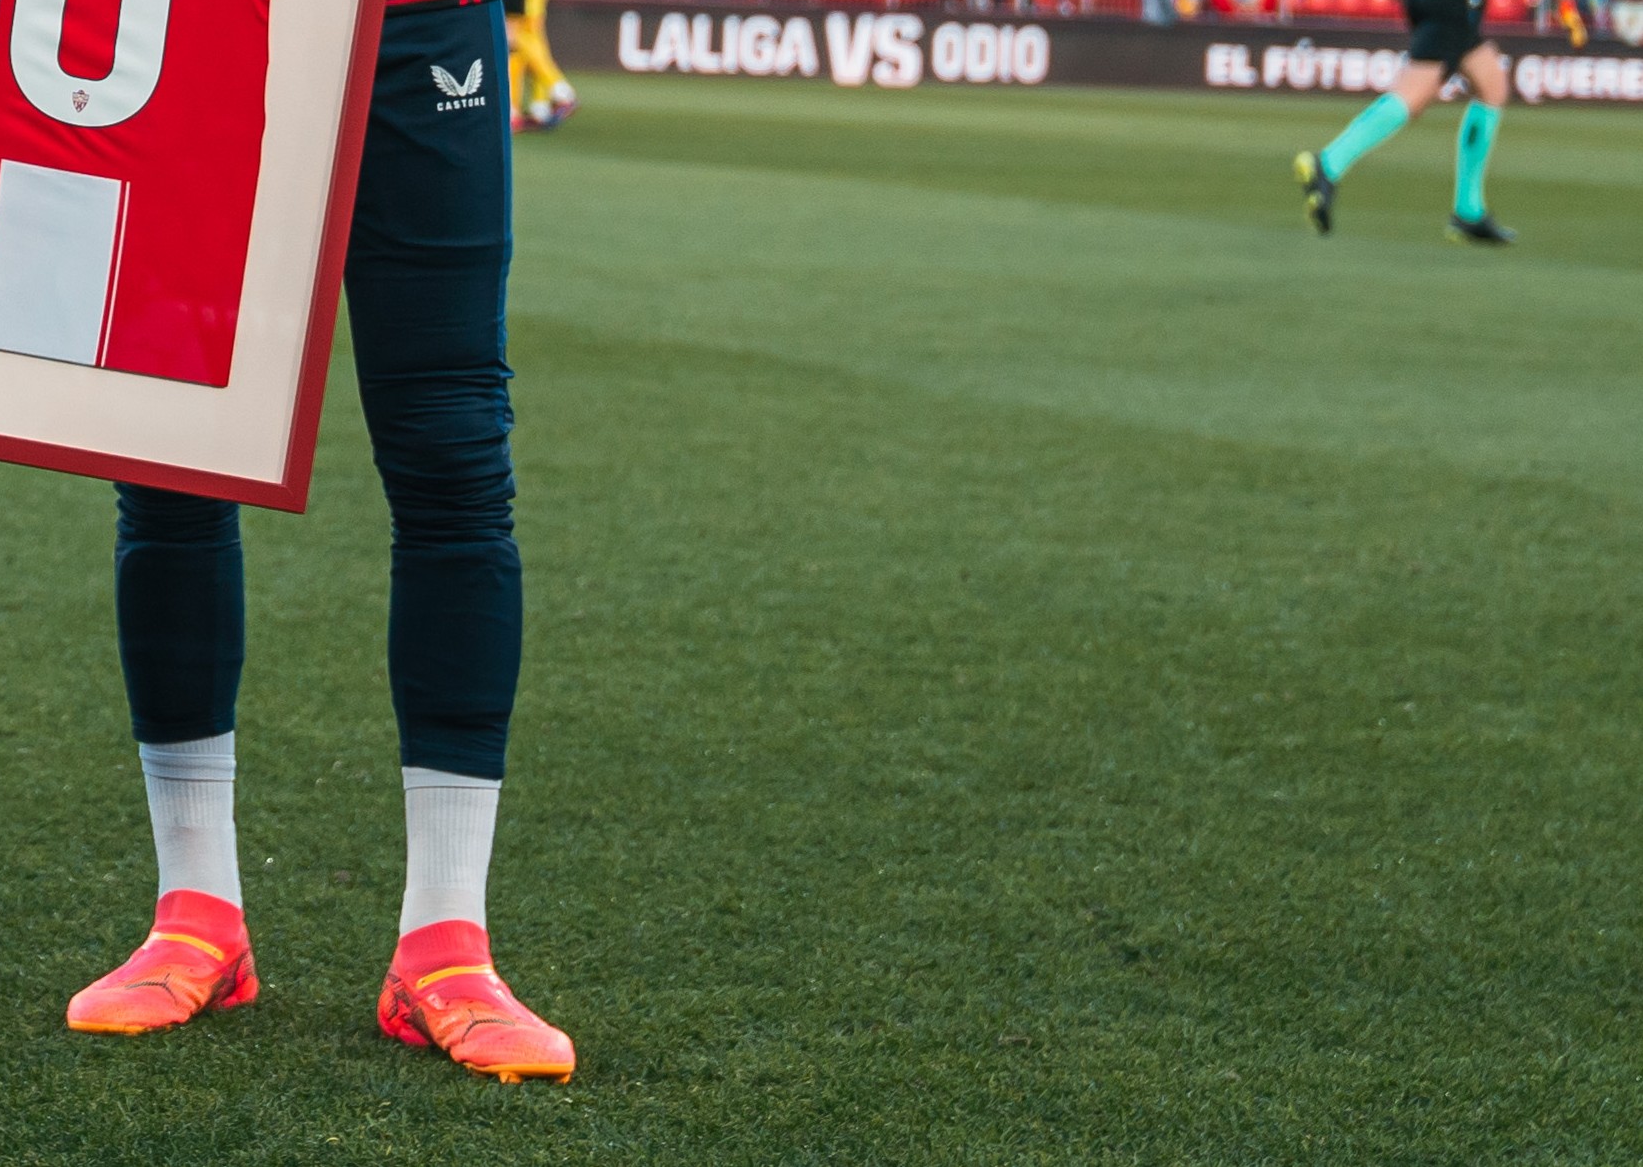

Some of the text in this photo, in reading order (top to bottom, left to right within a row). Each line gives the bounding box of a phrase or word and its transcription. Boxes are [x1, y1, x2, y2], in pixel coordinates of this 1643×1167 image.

[618, 10, 1051, 88] LALIGA VS ODIO
[1205, 42, 1257, 87] EL
[1263, 36, 1409, 93] FÚTBO
[436, 96, 486, 112] CASTORE
